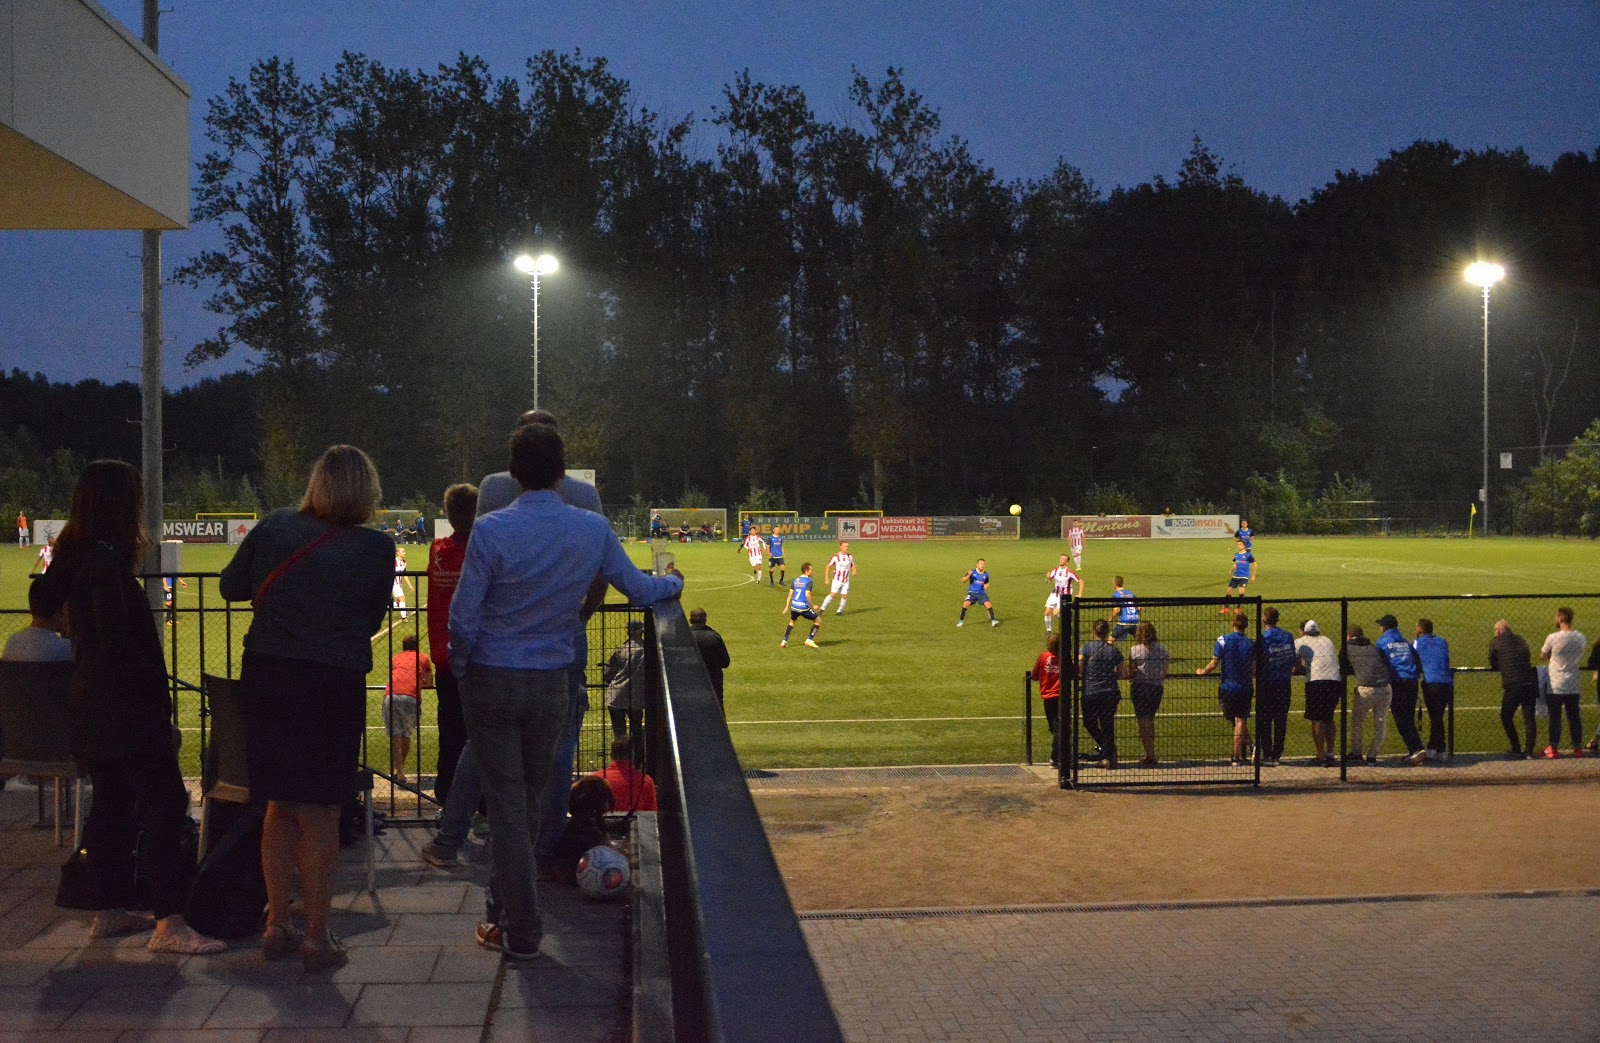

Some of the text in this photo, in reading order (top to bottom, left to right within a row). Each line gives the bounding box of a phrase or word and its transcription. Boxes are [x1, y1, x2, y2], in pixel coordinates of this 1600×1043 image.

[778, 523, 811, 534] WIP
[1079, 520, 1141, 533] Mertens
[794, 588, 802, 601] 7
